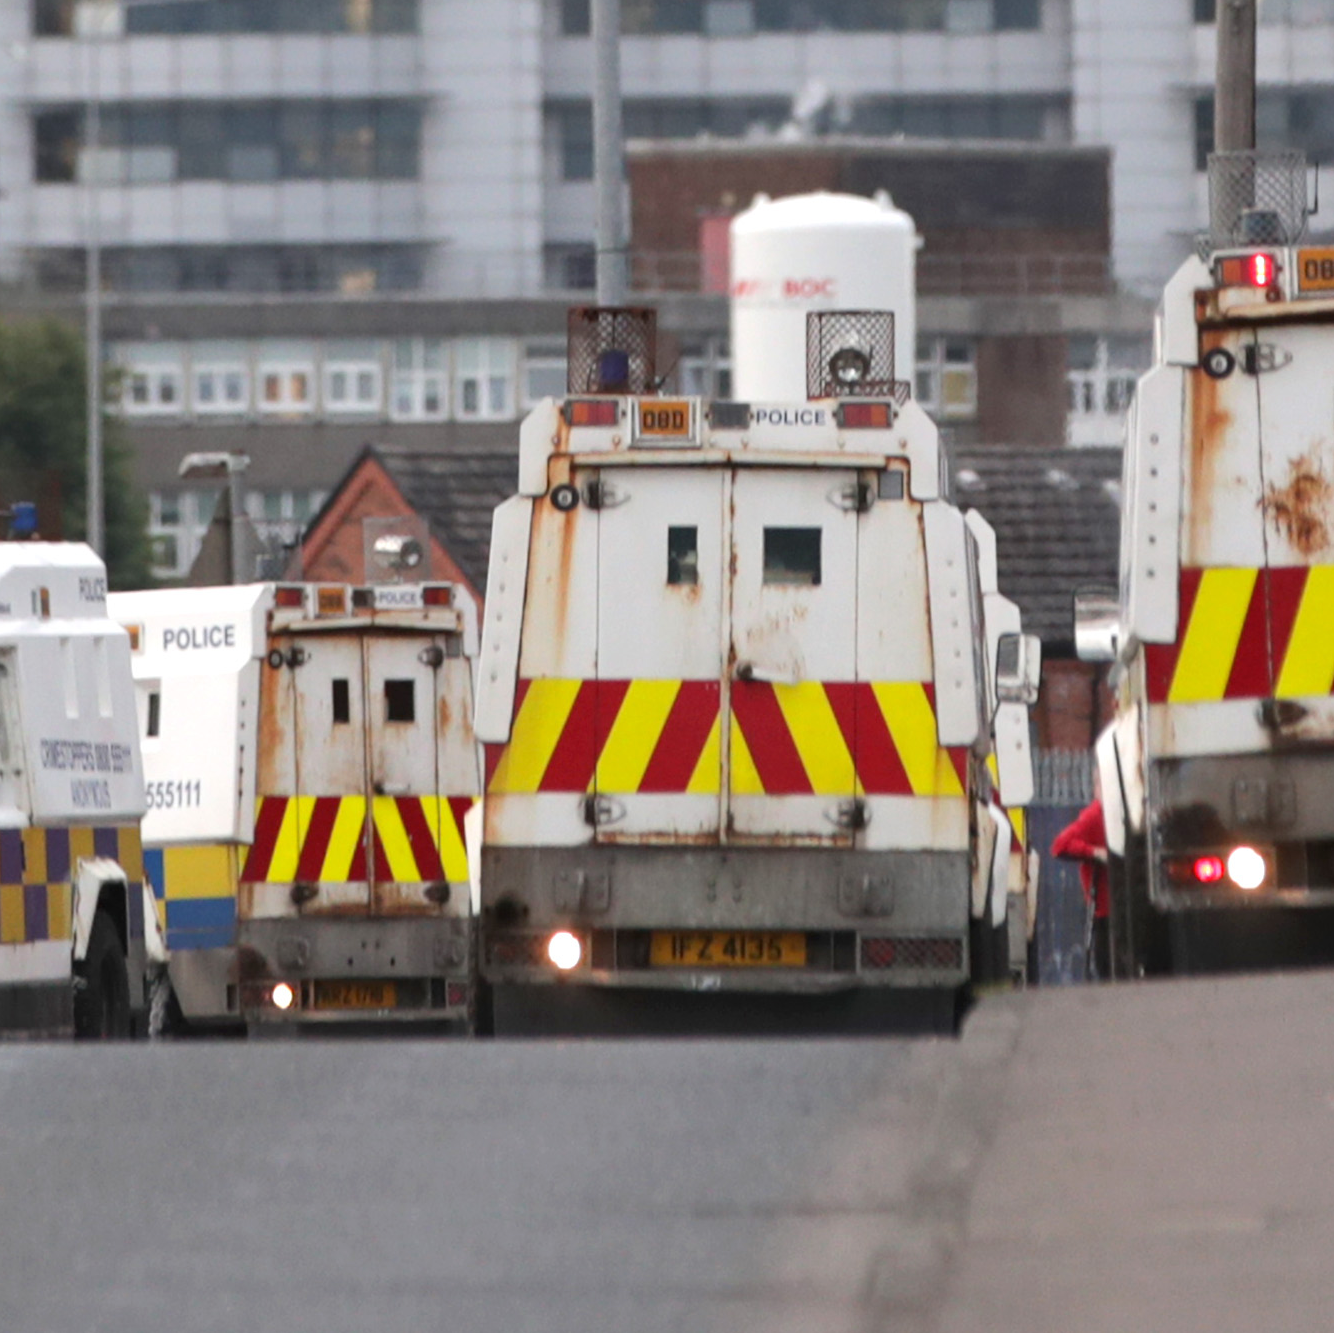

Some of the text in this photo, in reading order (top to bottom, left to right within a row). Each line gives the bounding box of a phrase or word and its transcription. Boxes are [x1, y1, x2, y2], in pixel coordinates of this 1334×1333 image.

[756, 410, 827, 425] POLICE
[379, 591, 416, 604] POLICE
[163, 625, 235, 651] POLICE
[146, 780, 201, 809] 555111
